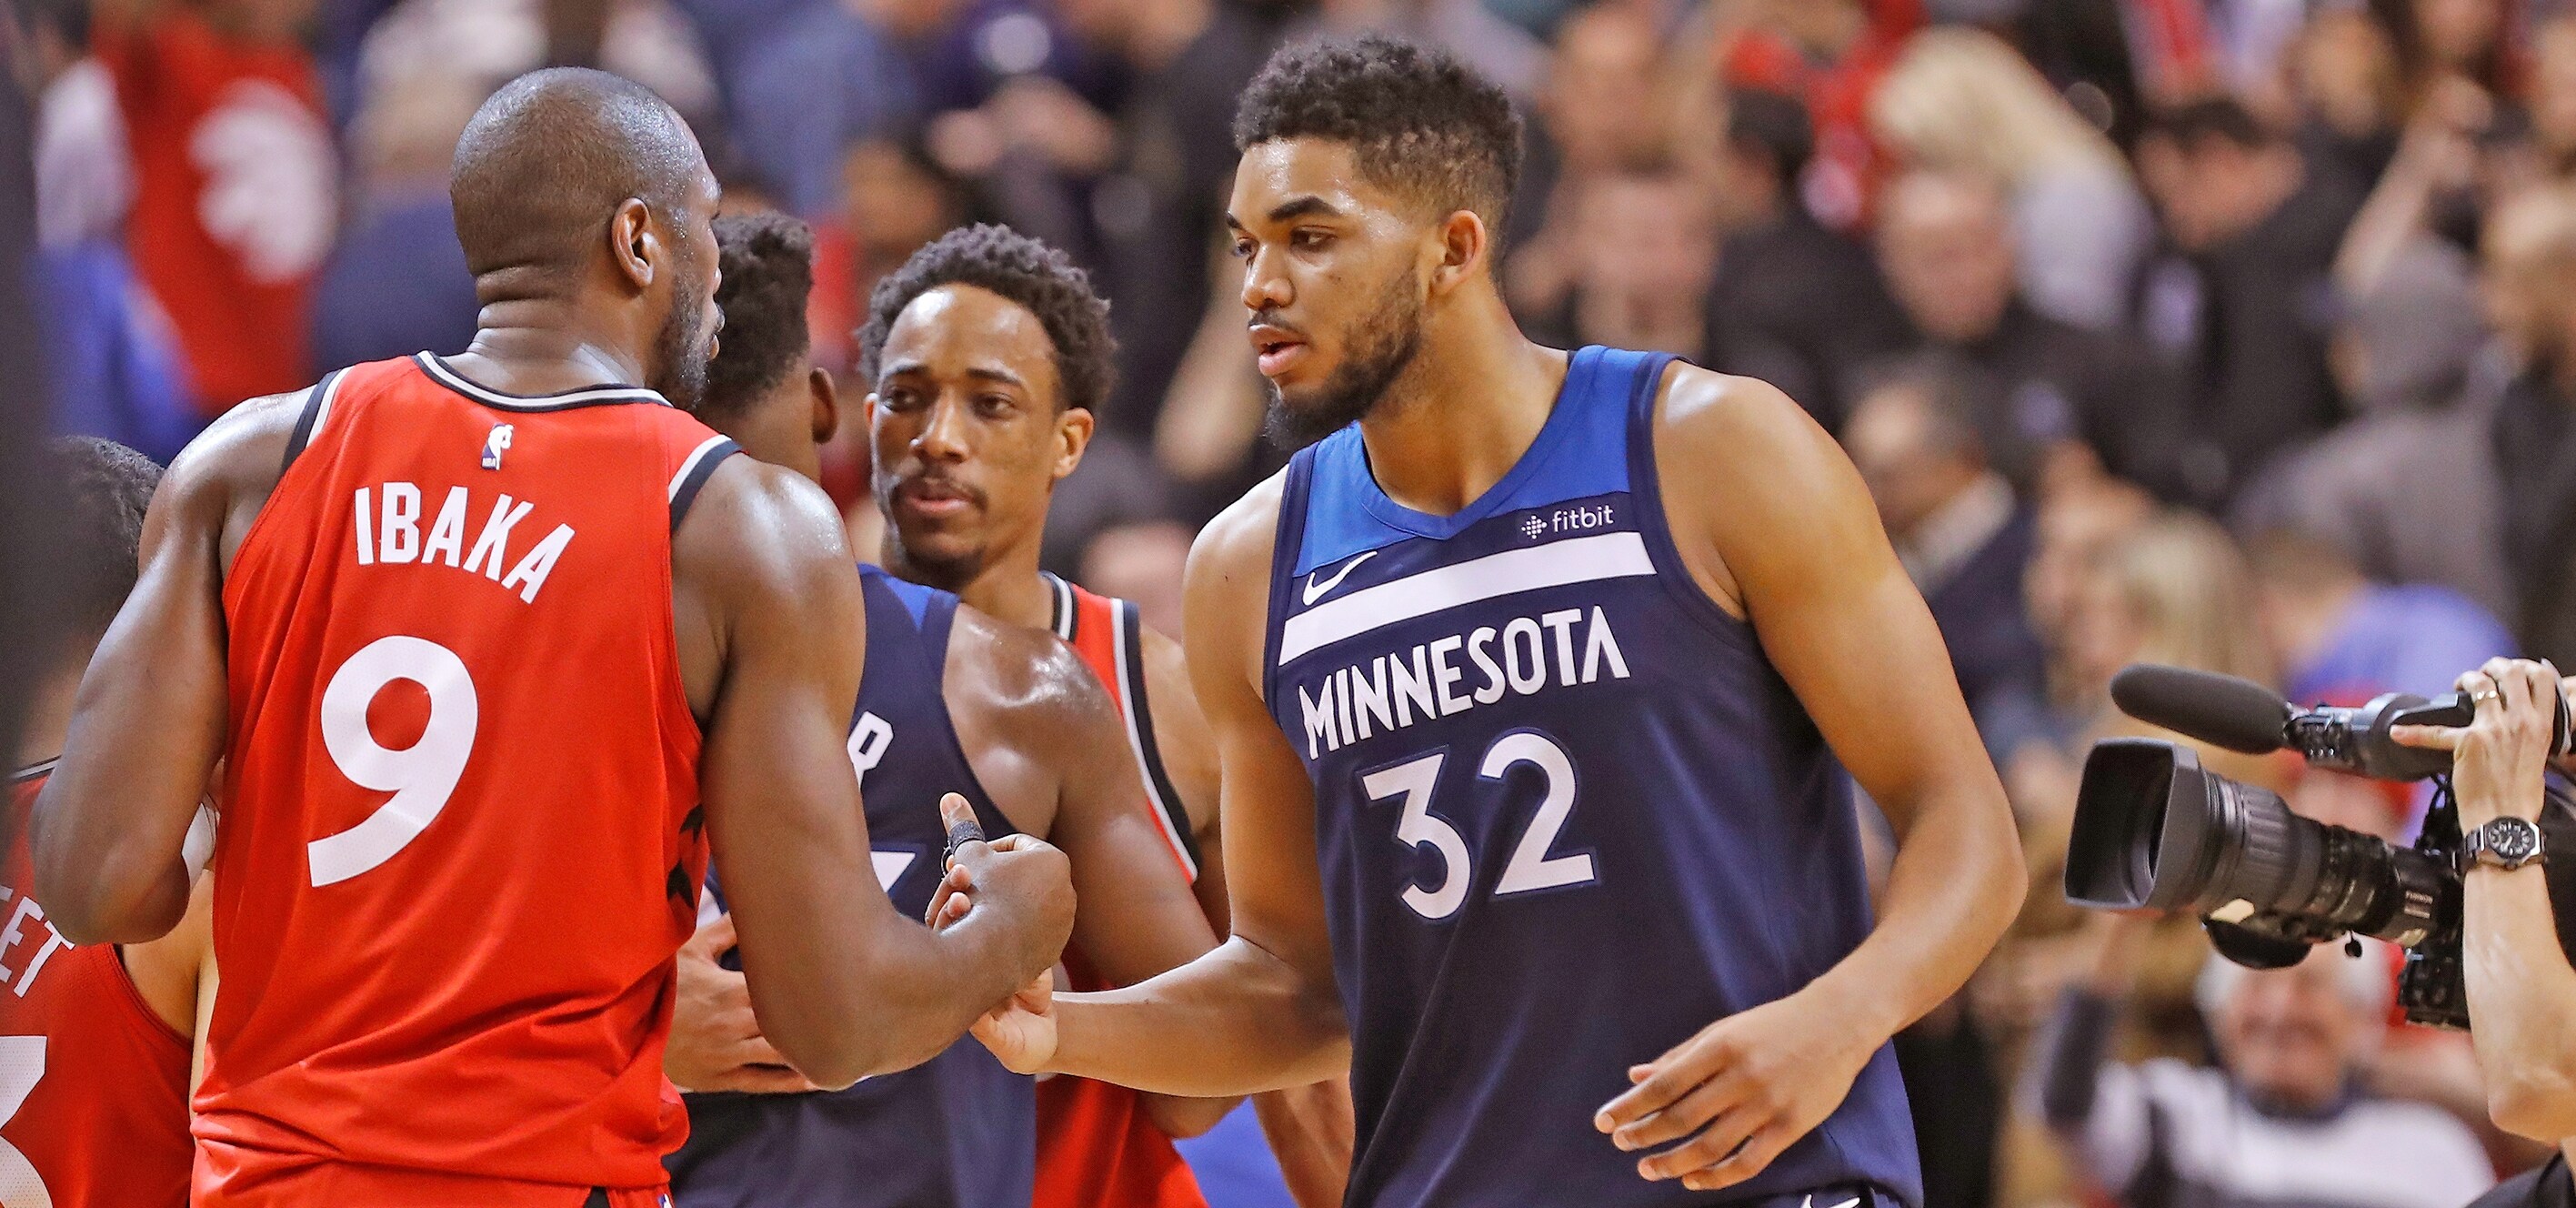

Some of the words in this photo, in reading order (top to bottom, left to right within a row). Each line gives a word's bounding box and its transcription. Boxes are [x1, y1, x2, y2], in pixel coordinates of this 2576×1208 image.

[355, 481, 576, 604] IBAKA
[1551, 504, 1614, 532] fitbit
[1298, 605, 1631, 760] MINNESOTA
[307, 635, 478, 888] 9
[1362, 732, 1596, 920] 32
[0, 885, 75, 998] ET
